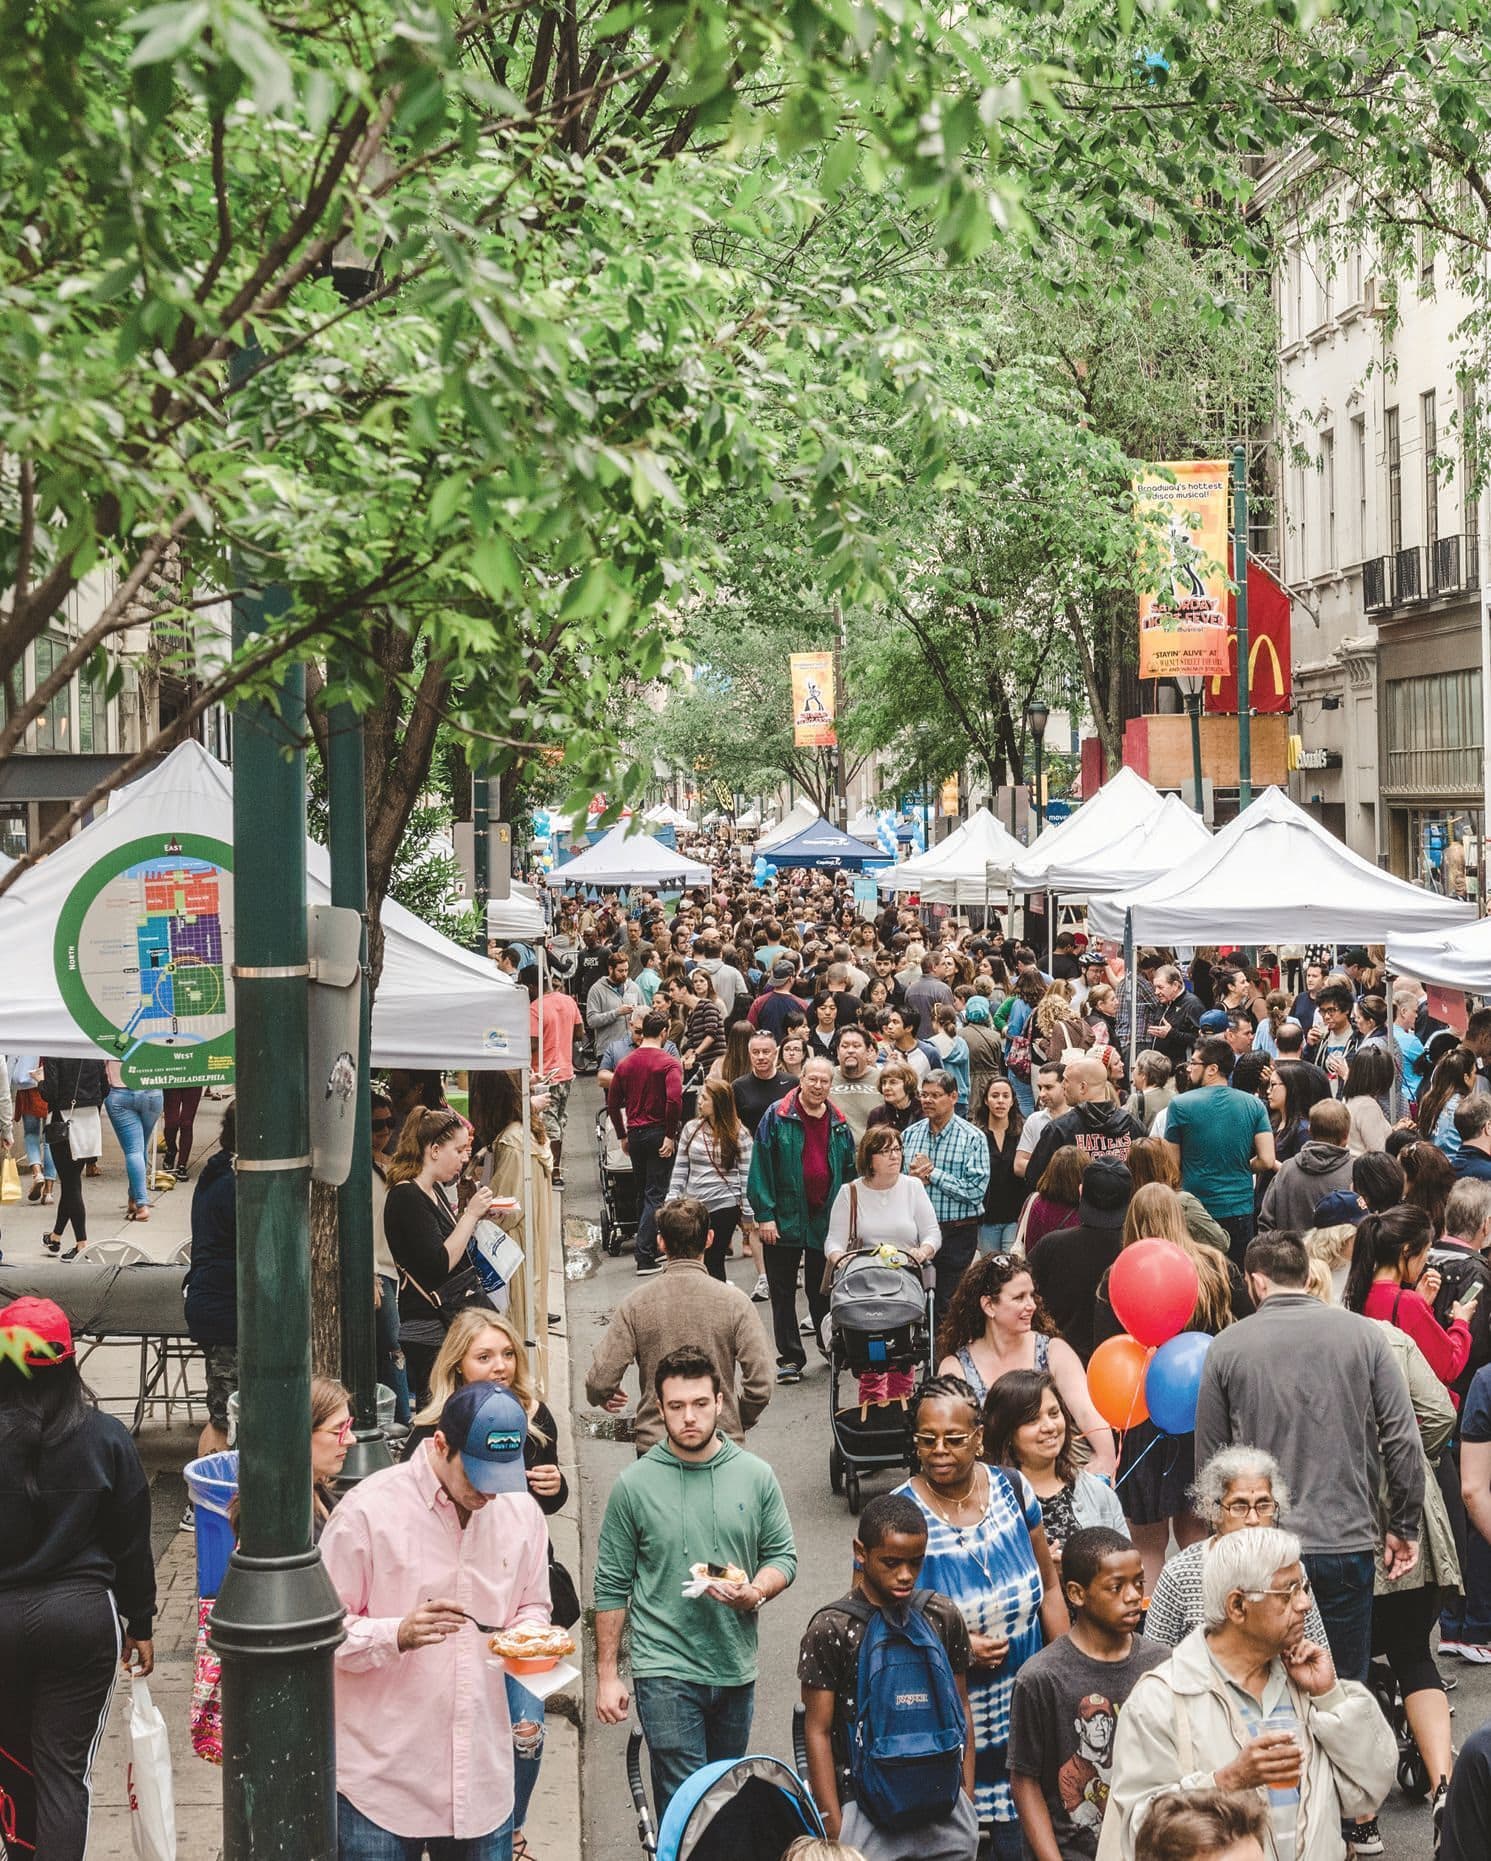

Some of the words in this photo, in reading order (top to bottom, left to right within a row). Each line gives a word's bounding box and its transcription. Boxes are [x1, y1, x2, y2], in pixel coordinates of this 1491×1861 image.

[1188, 482, 1223, 490] hottest
[1152, 492, 1174, 500] disco
[1176, 490, 1209, 499] musical!
[164, 844, 183, 852] EAST
[68, 945, 76, 971] NORTH
[173, 1052, 193, 1060] WEST
